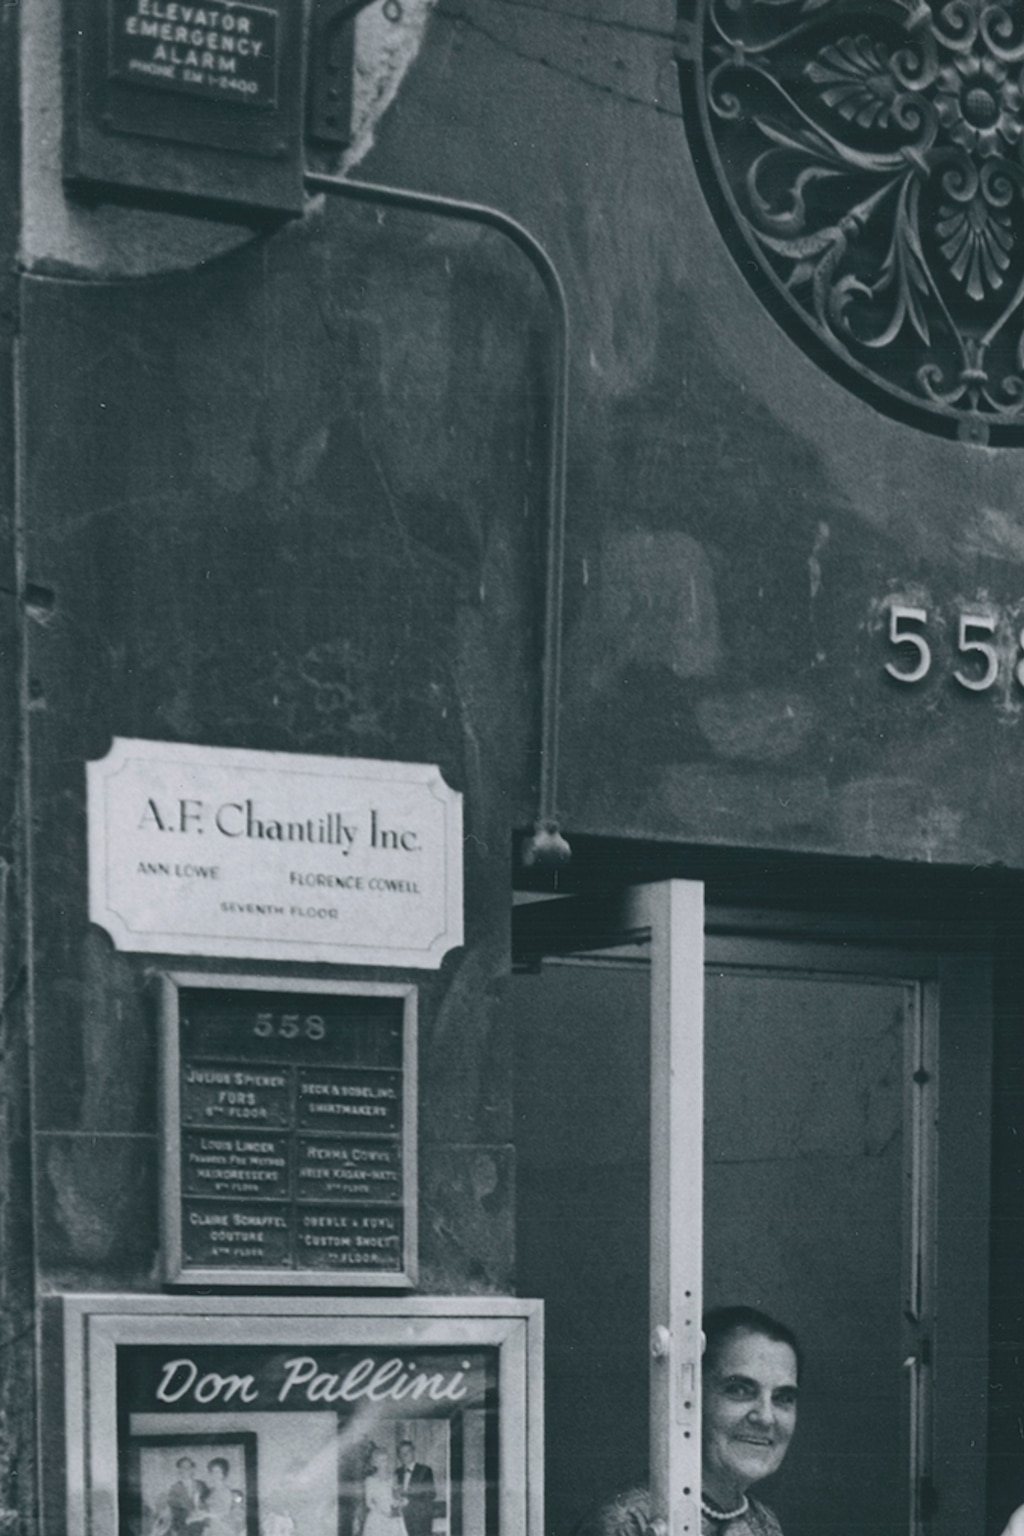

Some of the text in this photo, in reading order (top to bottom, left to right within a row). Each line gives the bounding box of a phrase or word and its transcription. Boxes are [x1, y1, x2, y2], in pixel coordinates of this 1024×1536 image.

[138, 0, 250, 33] ELEVATOR
[126, 17, 262, 56] EMERGENCY
[153, 44, 236, 73] ALARM
[137, 798, 423, 856] A.F. Chantilly Inc.
[137, 862, 420, 894] ANN LOWE FLORENCE COWELL
[221, 902, 338, 919] SEVENTH FLOOR
[253, 1013, 324, 1039] 558
[219, 1092, 256, 1106] FURS
[229, 1107, 267, 1119] FLOOR
[189, 1212, 229, 1226] CLAIRE
[210, 1231, 264, 1242] COUTURE
[156, 1357, 471, 1403] Don Pallini
